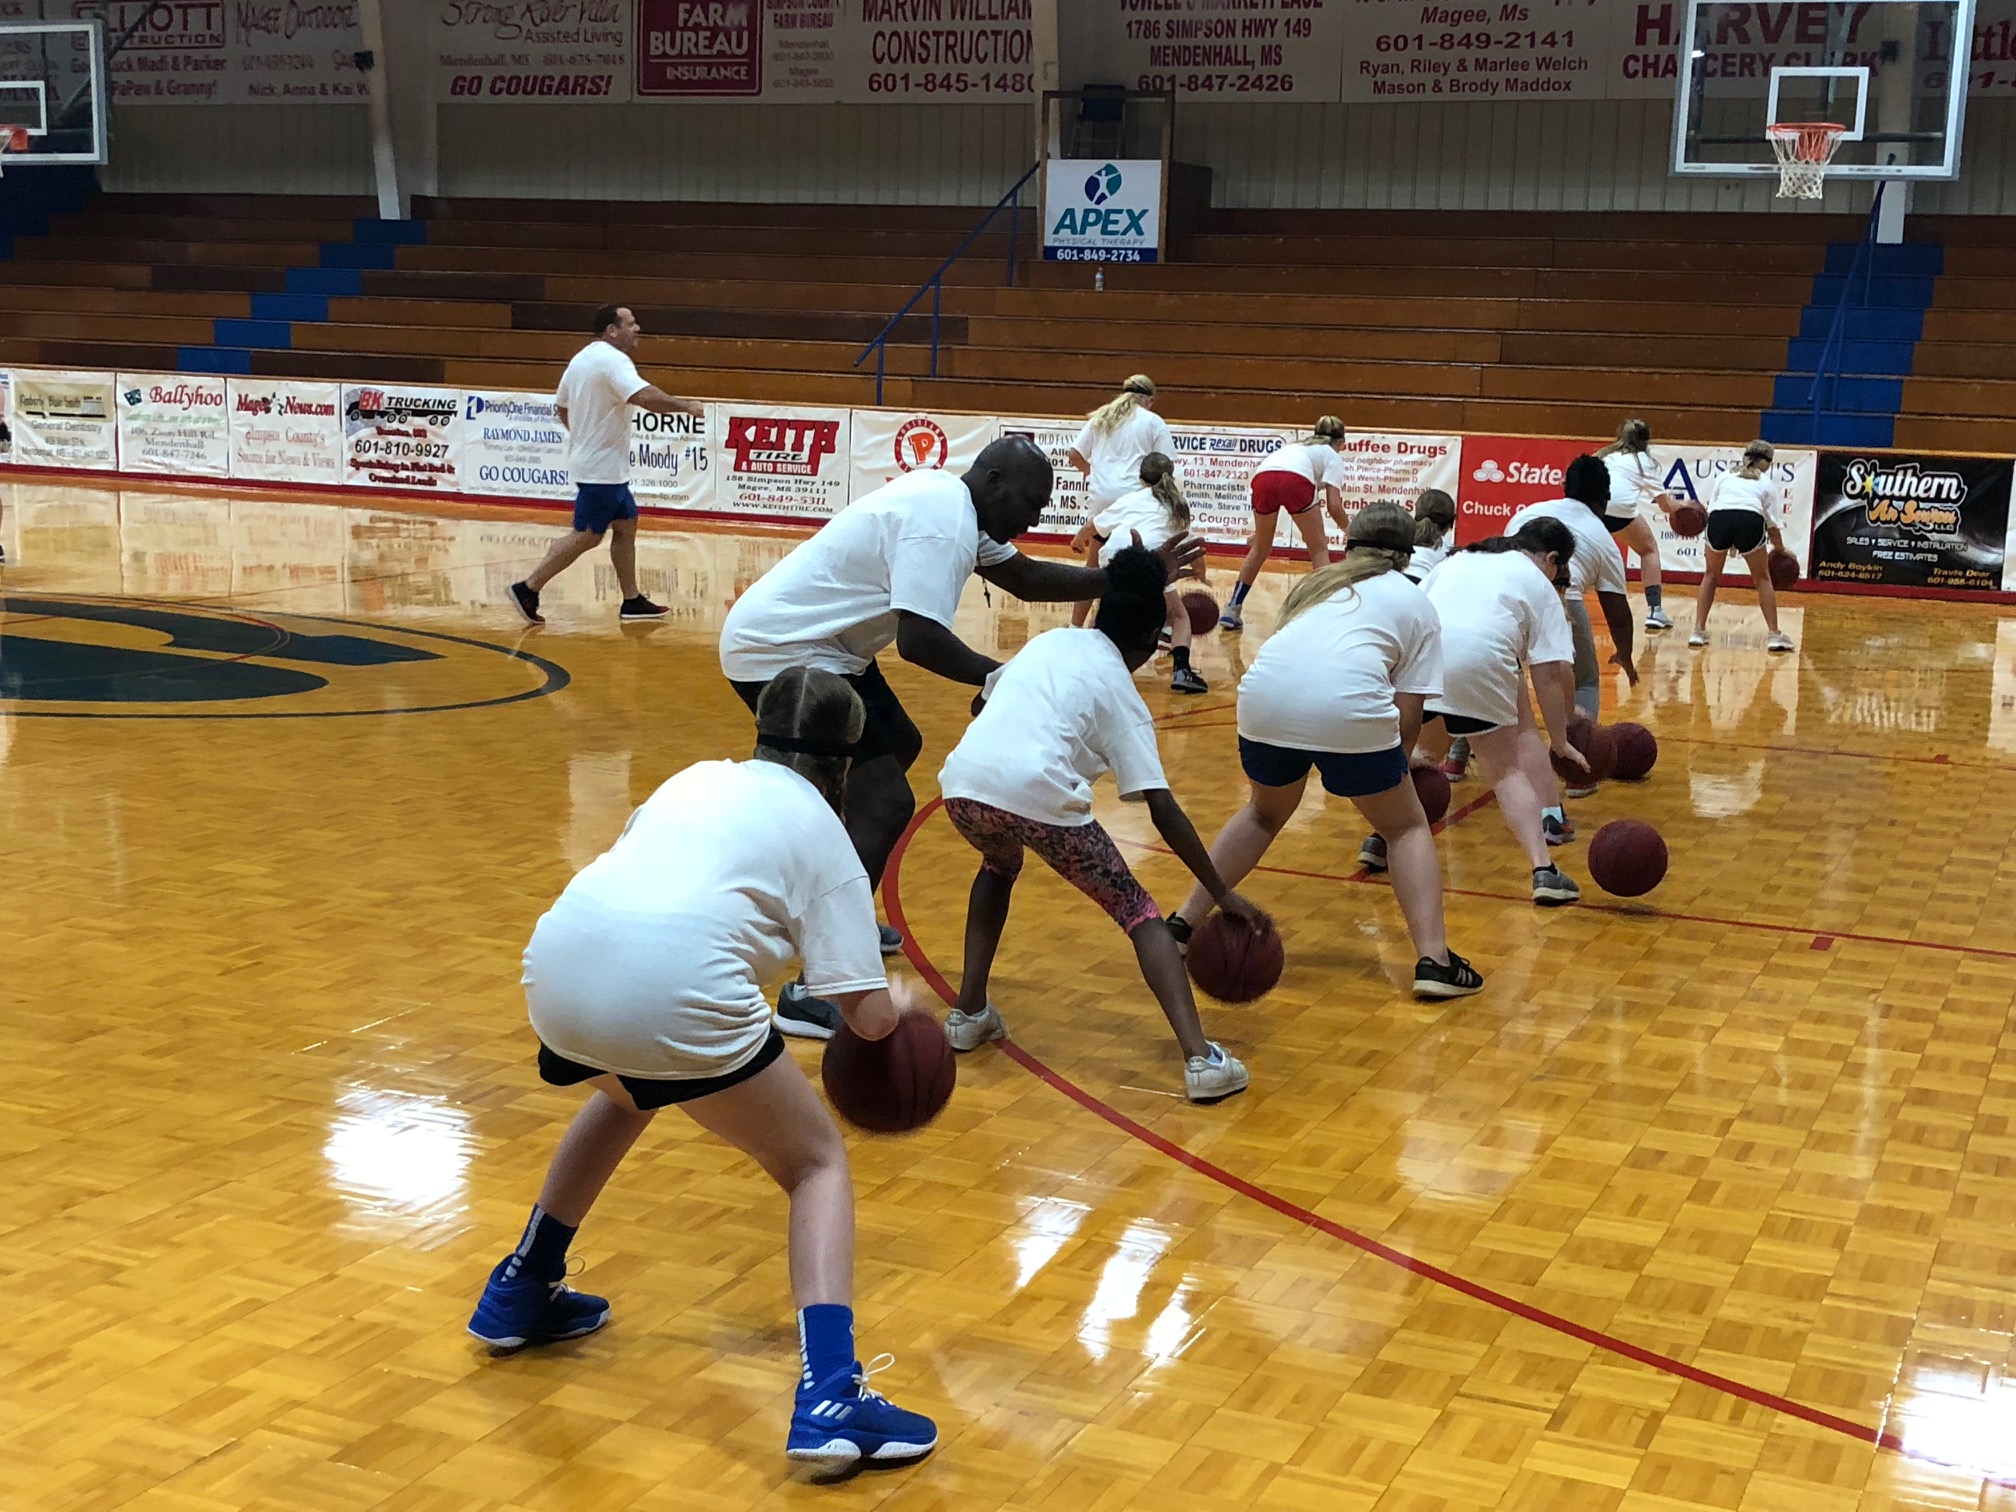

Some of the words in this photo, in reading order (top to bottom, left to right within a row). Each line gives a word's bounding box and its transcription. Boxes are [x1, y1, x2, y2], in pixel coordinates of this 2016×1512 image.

[678, 3, 749, 28] FARM
[861, 0, 942, 23] MARVIN
[1419, 6, 1492, 27] Magee,
[1498, 4, 1530, 22] Ms
[1126, 19, 1161, 39] 1786
[1165, 19, 1237, 39] SIMPSON
[1241, 18, 1280, 38] HWY
[1284, 18, 1313, 38] 149
[524, 29, 580, 44] Assisted
[583, 29, 625, 48] Living
[649, 31, 749, 56] BUREAU
[1374, 31, 1575, 52] 601-849-2141
[1149, 45, 1256, 70] MENDENHALL,
[1260, 44, 1284, 67] MS
[1621, 52, 1775, 78] CHACERY
[666, 66, 749, 81] INSURANCE
[1359, 60, 1405, 78] Ryan,
[1409, 59, 1452, 77] Riley
[1456, 58, 1469, 73] &
[1474, 57, 1531, 72] Marlee
[1535, 56, 1589, 72] Welch
[450, 75, 484, 96] GO
[489, 74, 614, 96] COUGARS!
[1137, 74, 1294, 92] 601-847-2426
[1372, 79, 1427, 95] Mason
[1431, 79, 1444, 93] &
[1448, 79, 1500, 96] Brody
[1504, 77, 1573, 93] Maddox
[1051, 208, 1151, 236] APEX
[1101, 238, 1147, 247] THERAPY
[1056, 248, 1142, 262] 601-849-2734
[149, 385, 224, 411] Ballyhoo
[386, 396, 458, 410] TRUCKING
[31, 420, 63, 432] General
[65, 422, 103, 435] Dentistry
[483, 427, 530, 442] RAYMOND
[531, 429, 563, 445] JAMES
[725, 416, 840, 456] KEITH
[145, 437, 206, 449] Mendenhall
[355, 440, 450, 459] 601-810-9927
[1171, 436, 1206, 450] RVICE
[1239, 438, 1283, 454] DRUGS
[1397, 441, 1448, 459] Drugs
[141, 449, 208, 461] 601-847-7246
[278, 450, 302, 466] News
[303, 451, 310, 467] &
[312, 452, 336, 469] Views
[639, 443, 679, 477] Moody
[684, 446, 709, 471] #15
[752, 450, 804, 462] TIRE
[1356, 456, 1391, 467] neighbor
[479, 465, 500, 481] GO
[502, 466, 570, 485] COUGARS!
[741, 460, 749, 471] &
[750, 461, 774, 473] AUTO
[776, 463, 813, 475] SERVICE
[1183, 468, 1250, 480] 601-847-2323
[1506, 461, 1564, 486] State
[775, 485, 793, 493] MS
[793, 478, 817, 487] Hwy
[820, 480, 841, 488] 149
[738, 491, 827, 506] 601-849-5311
[1214, 492, 1248, 502] Melinda
[1217, 502, 1241, 511] Steve
[1461, 500, 1513, 518] Chuck
[1039, 511, 1088, 526] anninauto
[1198, 512, 1249, 527] Cougars
[1846, 536, 1870, 546] SALES
[1877, 538, 1910, 549] SERVICE
[1916, 540, 1968, 552] INSTALLATION
[1872, 550, 1894, 560] FREE
[1894, 551, 1939, 563] ESTIMATES
[1818, 560, 1846, 571] Andy
[1848, 561, 1884, 572] Boykin
[1932, 567, 1964, 577] Travis
